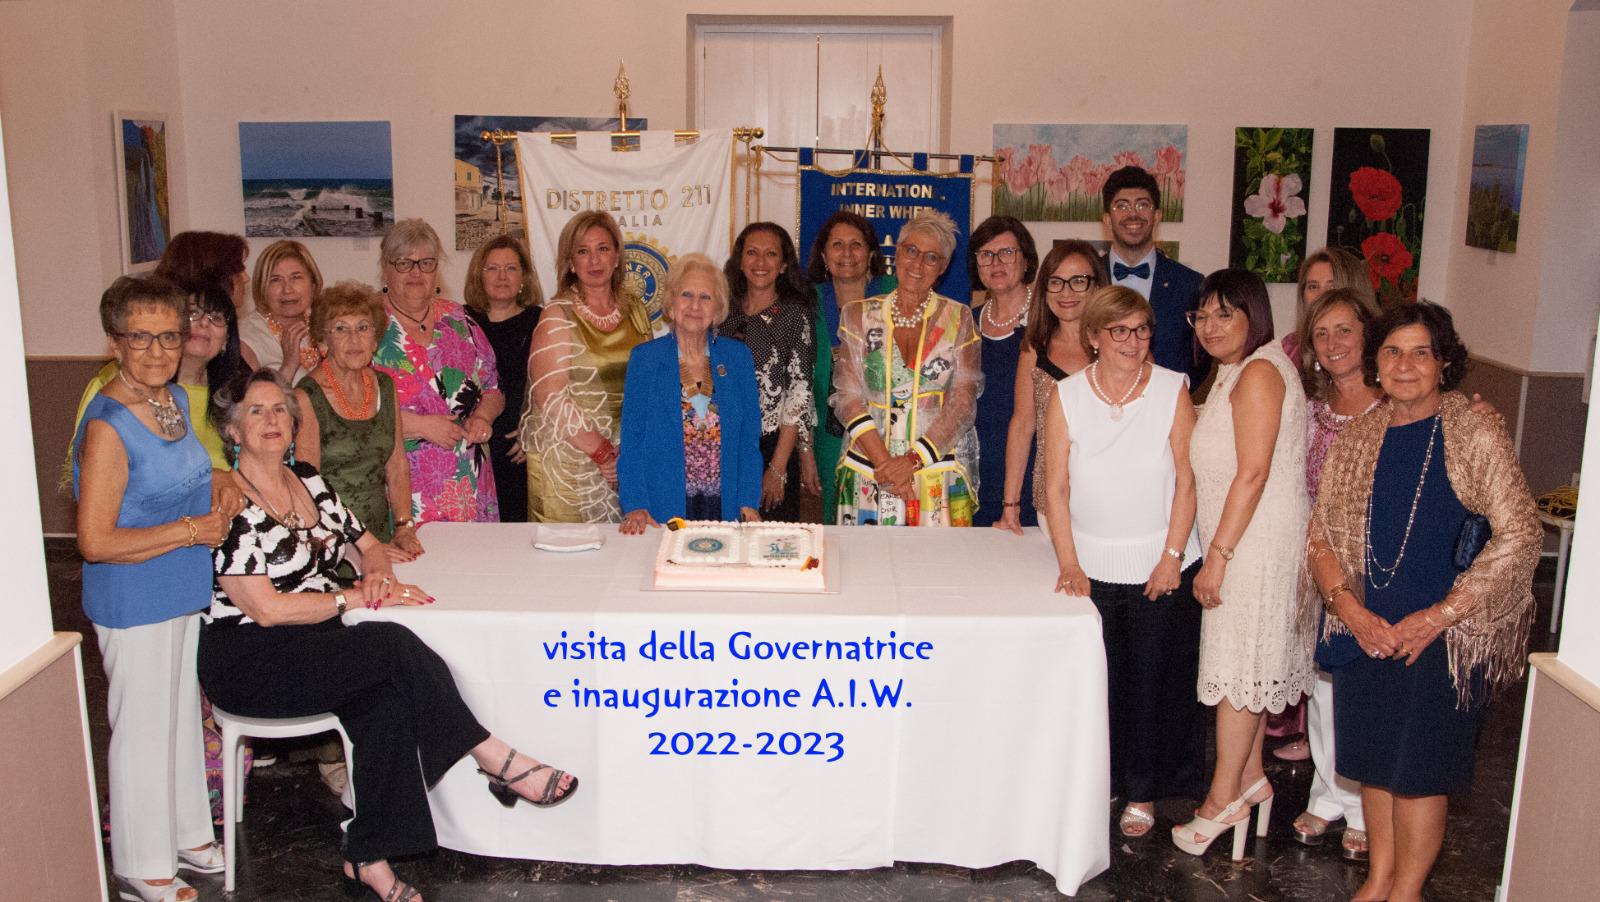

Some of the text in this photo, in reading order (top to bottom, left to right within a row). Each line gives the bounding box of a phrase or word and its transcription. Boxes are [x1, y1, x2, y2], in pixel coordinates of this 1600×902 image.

[831, 182, 946, 200] INTERNATION
[546, 188, 669, 212] DISTRETTO
[889, 205, 934, 219] WHE
[619, 214, 663, 228] ALIA
